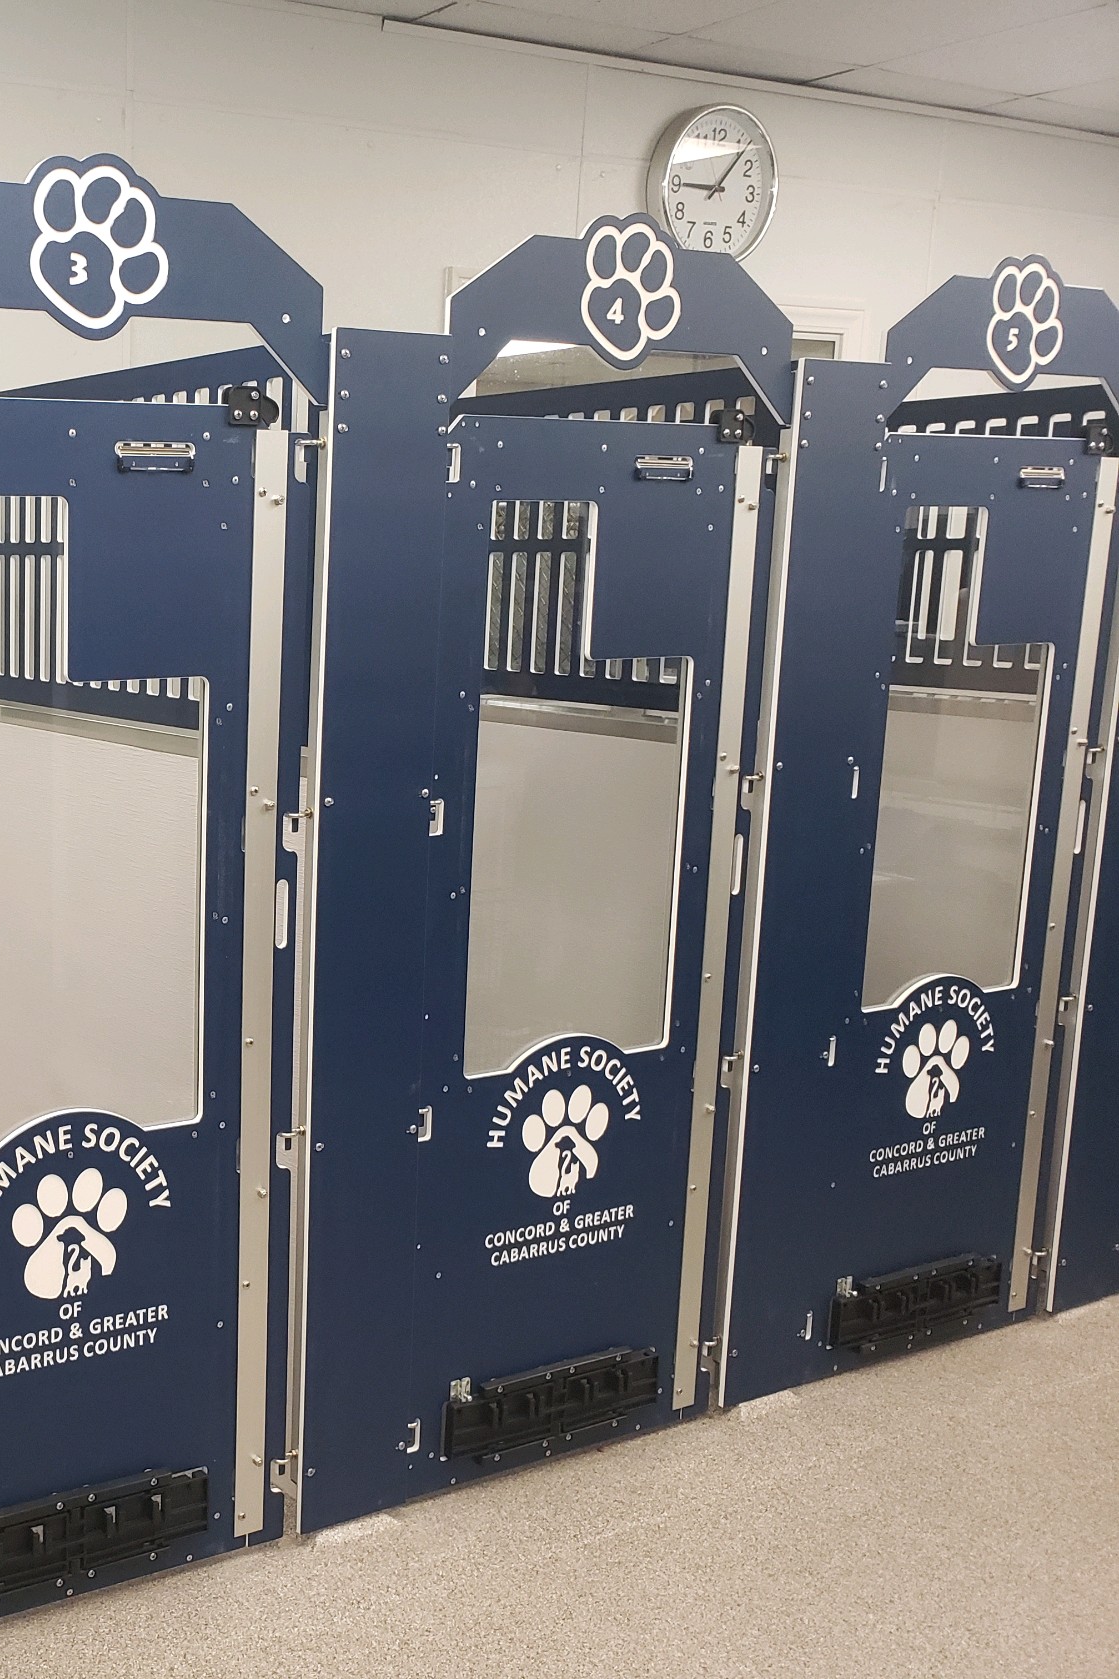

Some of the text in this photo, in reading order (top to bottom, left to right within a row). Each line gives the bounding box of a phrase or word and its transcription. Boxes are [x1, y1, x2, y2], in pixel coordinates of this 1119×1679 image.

[712, 127, 727, 147] 12
[743, 159, 753, 177] 2
[671, 174, 681, 193] 9
[745, 185, 755, 203] 3
[675, 202, 685, 220] 8
[737, 210, 747, 228] 4
[686, 221, 696, 239] 7
[703, 231, 714, 248] 6
[722, 226, 732, 244] 5
[69, 252, 88, 286] 3
[606, 297, 625, 325] 4
[1006, 327, 1020, 352] 5
[875, 985, 995, 1074] HUMANE SOCIETY
[486, 1045, 641, 1148] HUMANE SOCIETY
[922, 1121, 937, 1135] OF
[869, 1127, 985, 1163] CONCORD & GREATER
[81, 1123, 171, 1208] SOCIETY
[873, 1145, 978, 1178] CABARRUS COUNTY
[552, 1200, 571, 1216] OF
[484, 1204, 634, 1249] CONCORD & GREATER
[491, 1224, 625, 1266] CABARRUS COUNTY
[59, 1301, 82, 1320] OF
[69, 1322, 83, 1339] &
[89, 1304, 169, 1335] GREATER
[83, 1328, 158, 1358] COUNTY
